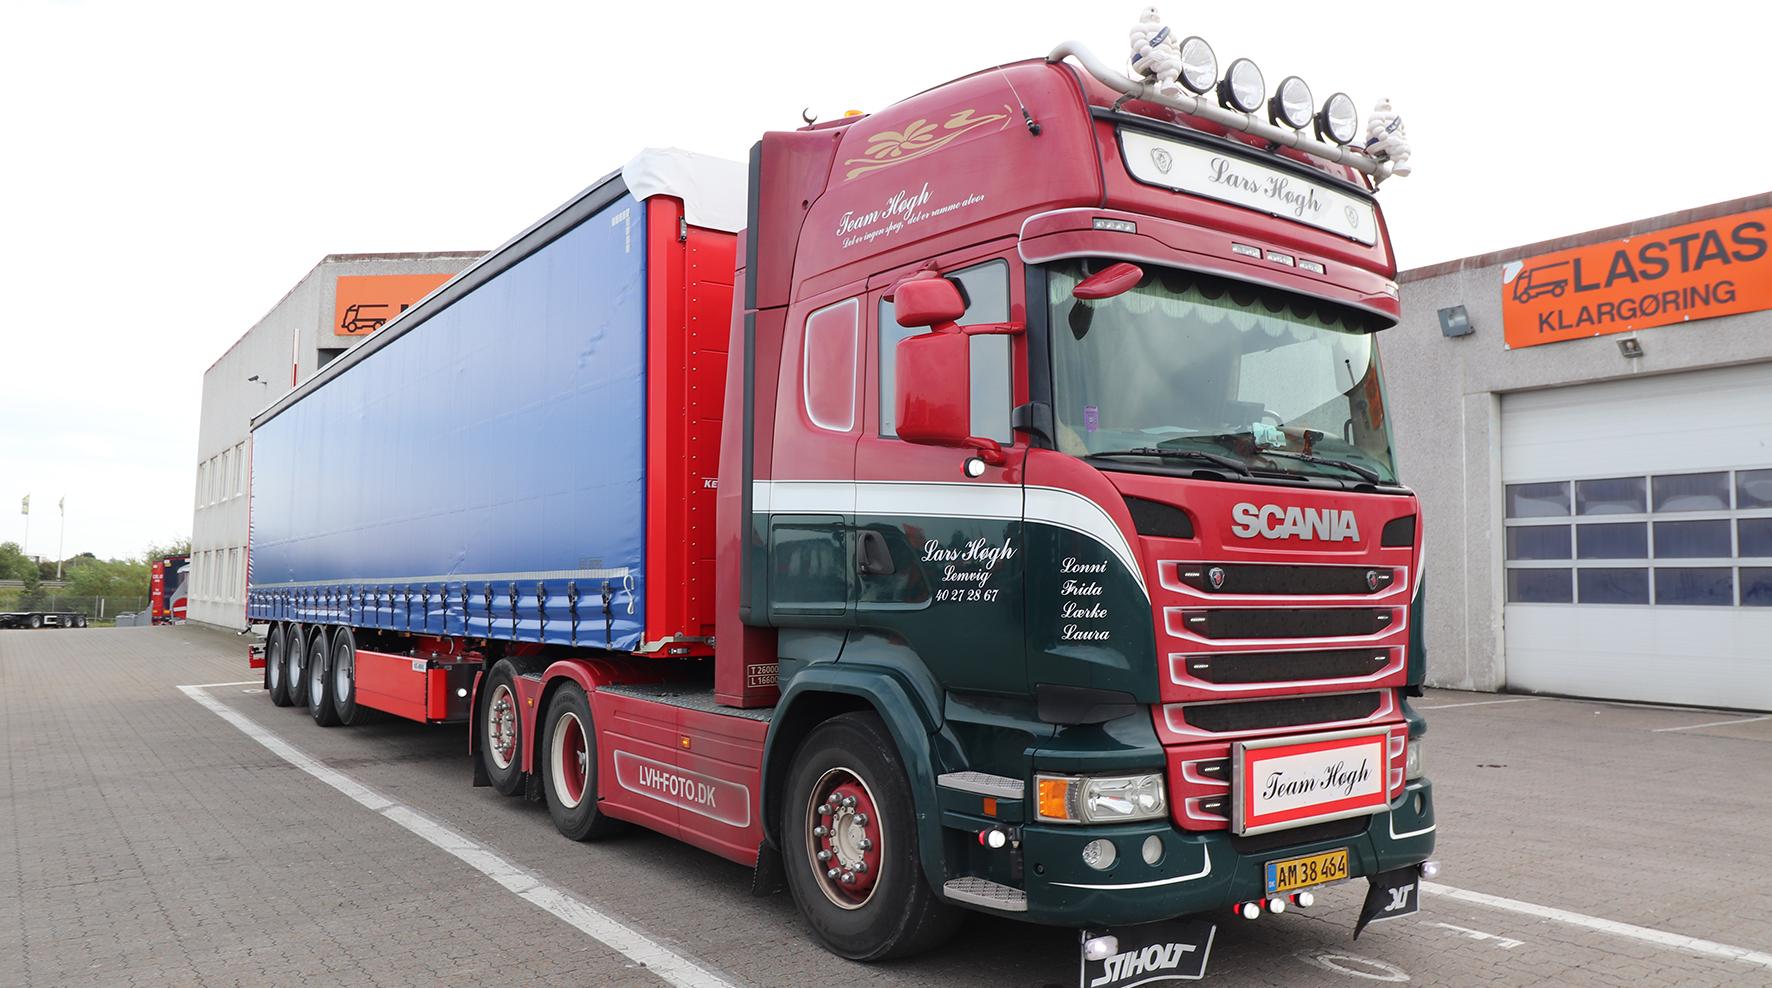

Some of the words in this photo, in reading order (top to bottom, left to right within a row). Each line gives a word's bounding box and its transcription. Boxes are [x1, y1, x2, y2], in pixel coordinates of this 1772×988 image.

[1208, 157, 1261, 193] Lars
[836, 210, 882, 237] Team
[1573, 221, 1768, 293] LASTAS
[1538, 280, 1736, 334] KLARGØRING
[1231, 502, 1361, 542] SCANIA
[921, 539, 962, 562] Lars
[961, 537, 1018, 570] Høgh
[1060, 557, 1108, 573] Lonni
[942, 564, 993, 588] Lemvig
[1060, 579, 1103, 596] Frida
[935, 589, 950, 602] 40
[950, 589, 966, 602] 27
[966, 589, 983, 601] 28
[983, 589, 1000, 602] 67
[1060, 601, 1108, 618] Lærke
[1061, 623, 1111, 640] Laura
[750, 666, 756, 675] T
[751, 677, 757, 685] L
[639, 764, 717, 808] LVH-FOTO.DK
[1262, 771, 1318, 801] Team
[1278, 865, 1297, 887] AM
[1300, 861, 1317, 883] 38
[1321, 855, 1345, 878] 464
[1090, 943, 1197, 988] STIHOLT
